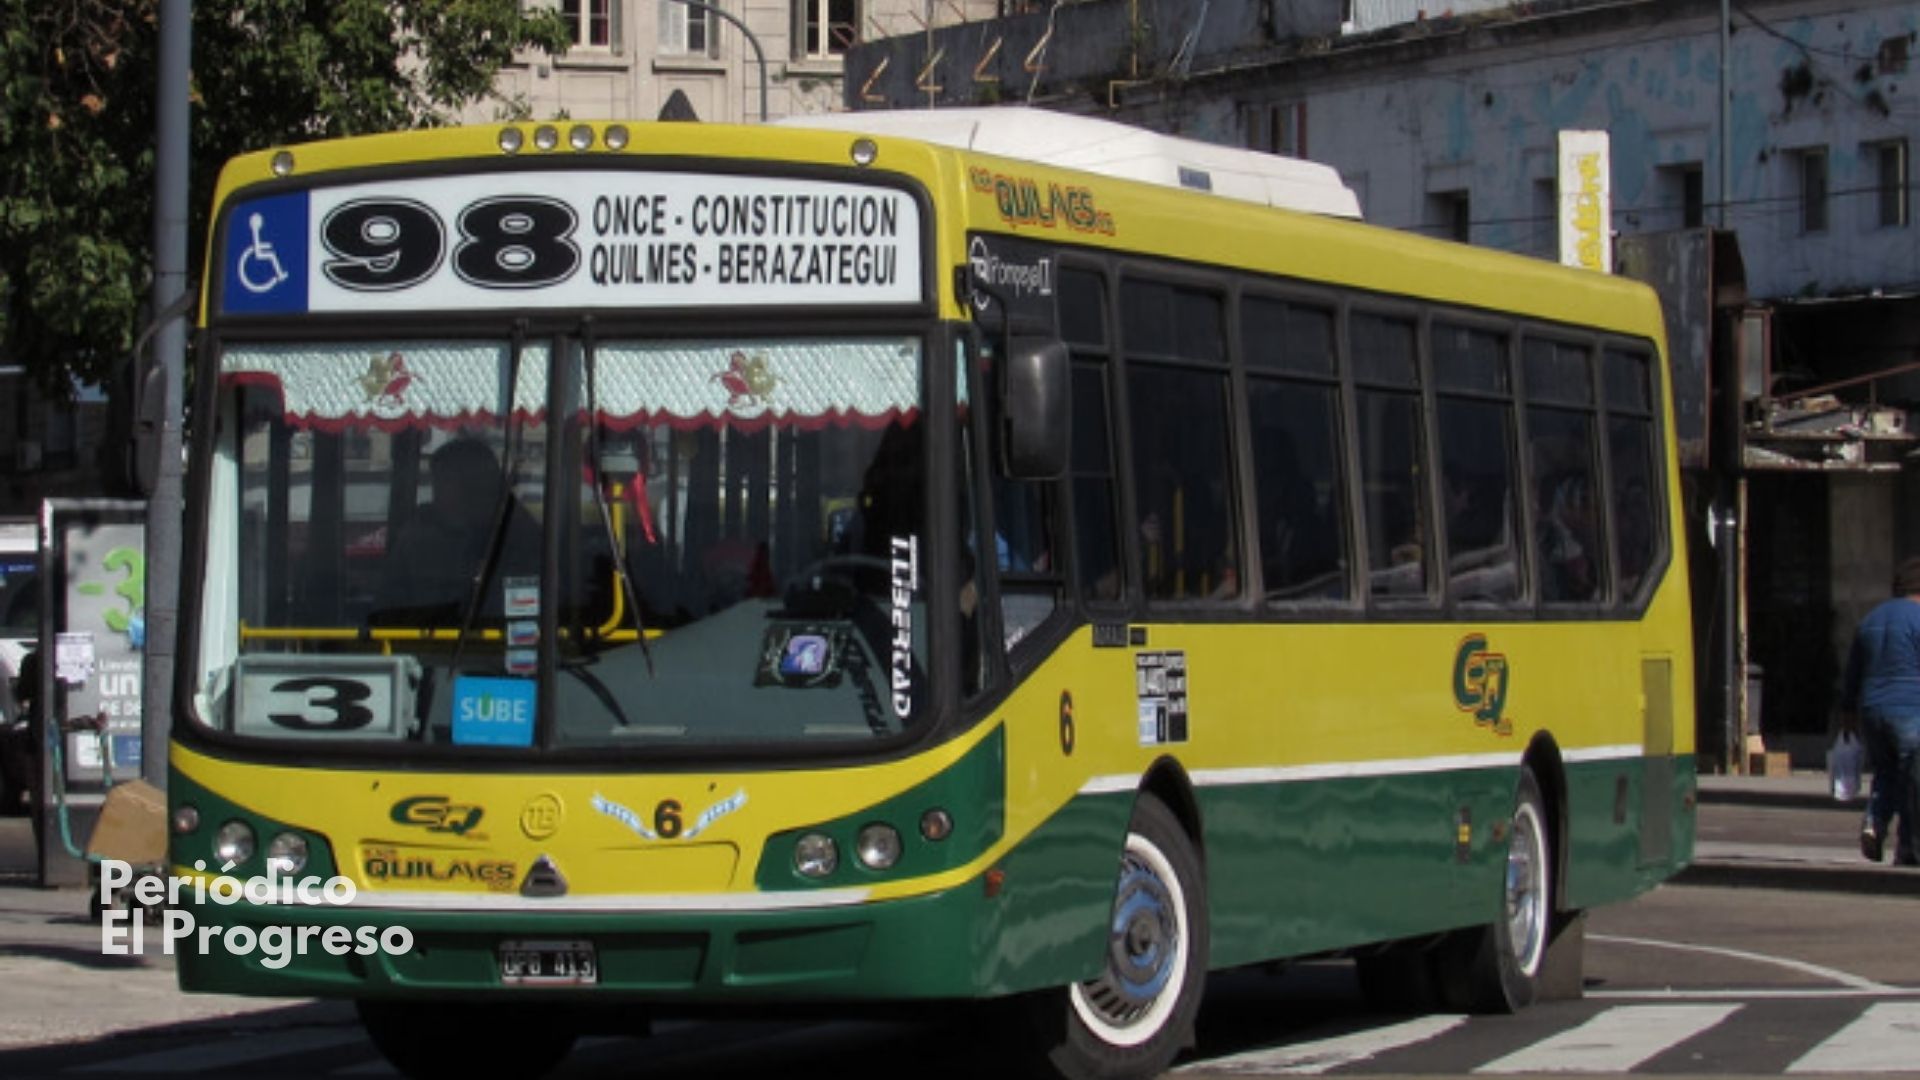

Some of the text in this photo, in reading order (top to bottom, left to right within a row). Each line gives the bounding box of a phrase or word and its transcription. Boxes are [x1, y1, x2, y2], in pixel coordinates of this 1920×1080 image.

[592, 195, 667, 237] ONCE
[691, 195, 898, 237] CONSTITUCION
[320, 196, 581, 292] 98
[590, 243, 697, 287] QUILMES
[717, 244, 897, 285] BERAZATEGUI
[268, 677, 374, 731] 3
[460, 692, 527, 722] SUBE
[1059, 689, 1076, 757] 6
[654, 799, 682, 840] 6
